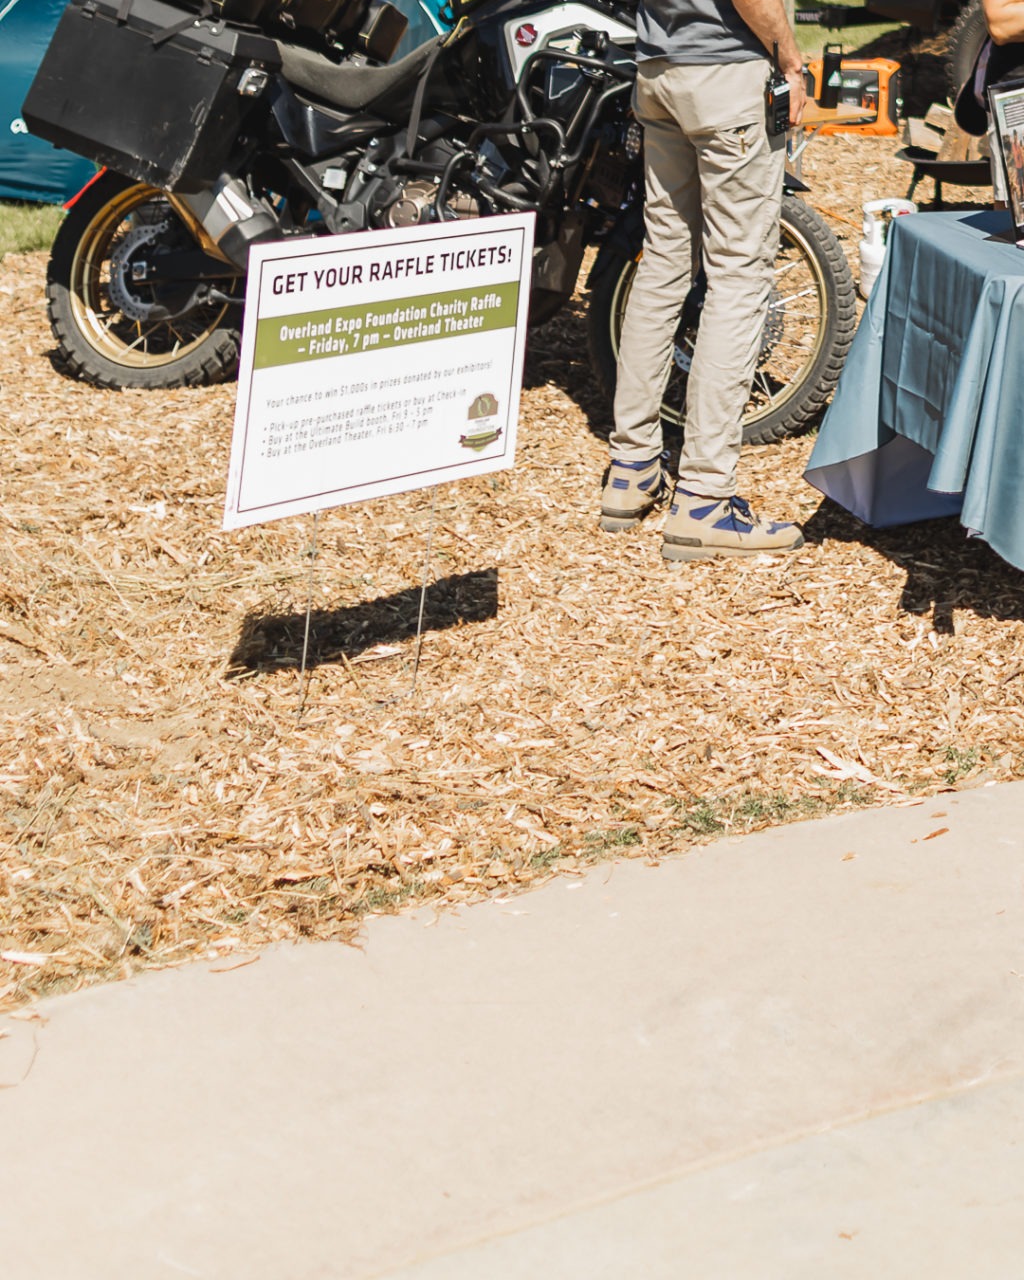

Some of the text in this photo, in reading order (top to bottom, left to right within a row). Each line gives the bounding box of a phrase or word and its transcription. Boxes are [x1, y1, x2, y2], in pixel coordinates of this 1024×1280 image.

[273, 246, 512, 295] GET YOUR RAFFLE TICKETS!
[280, 293, 502, 341] Overland Expo Foundation Charity Raffle
[309, 336, 349, 355] Friday,
[353, 333, 359, 347] 7
[362, 332, 379, 350] pm
[394, 321, 441, 341] Overland
[444, 315, 484, 333] Theater
[286, 393, 312, 406] chance
[314, 391, 322, 400] to
[325, 388, 338, 398] win
[403, 370, 432, 384] donated
[434, 370, 441, 379] by
